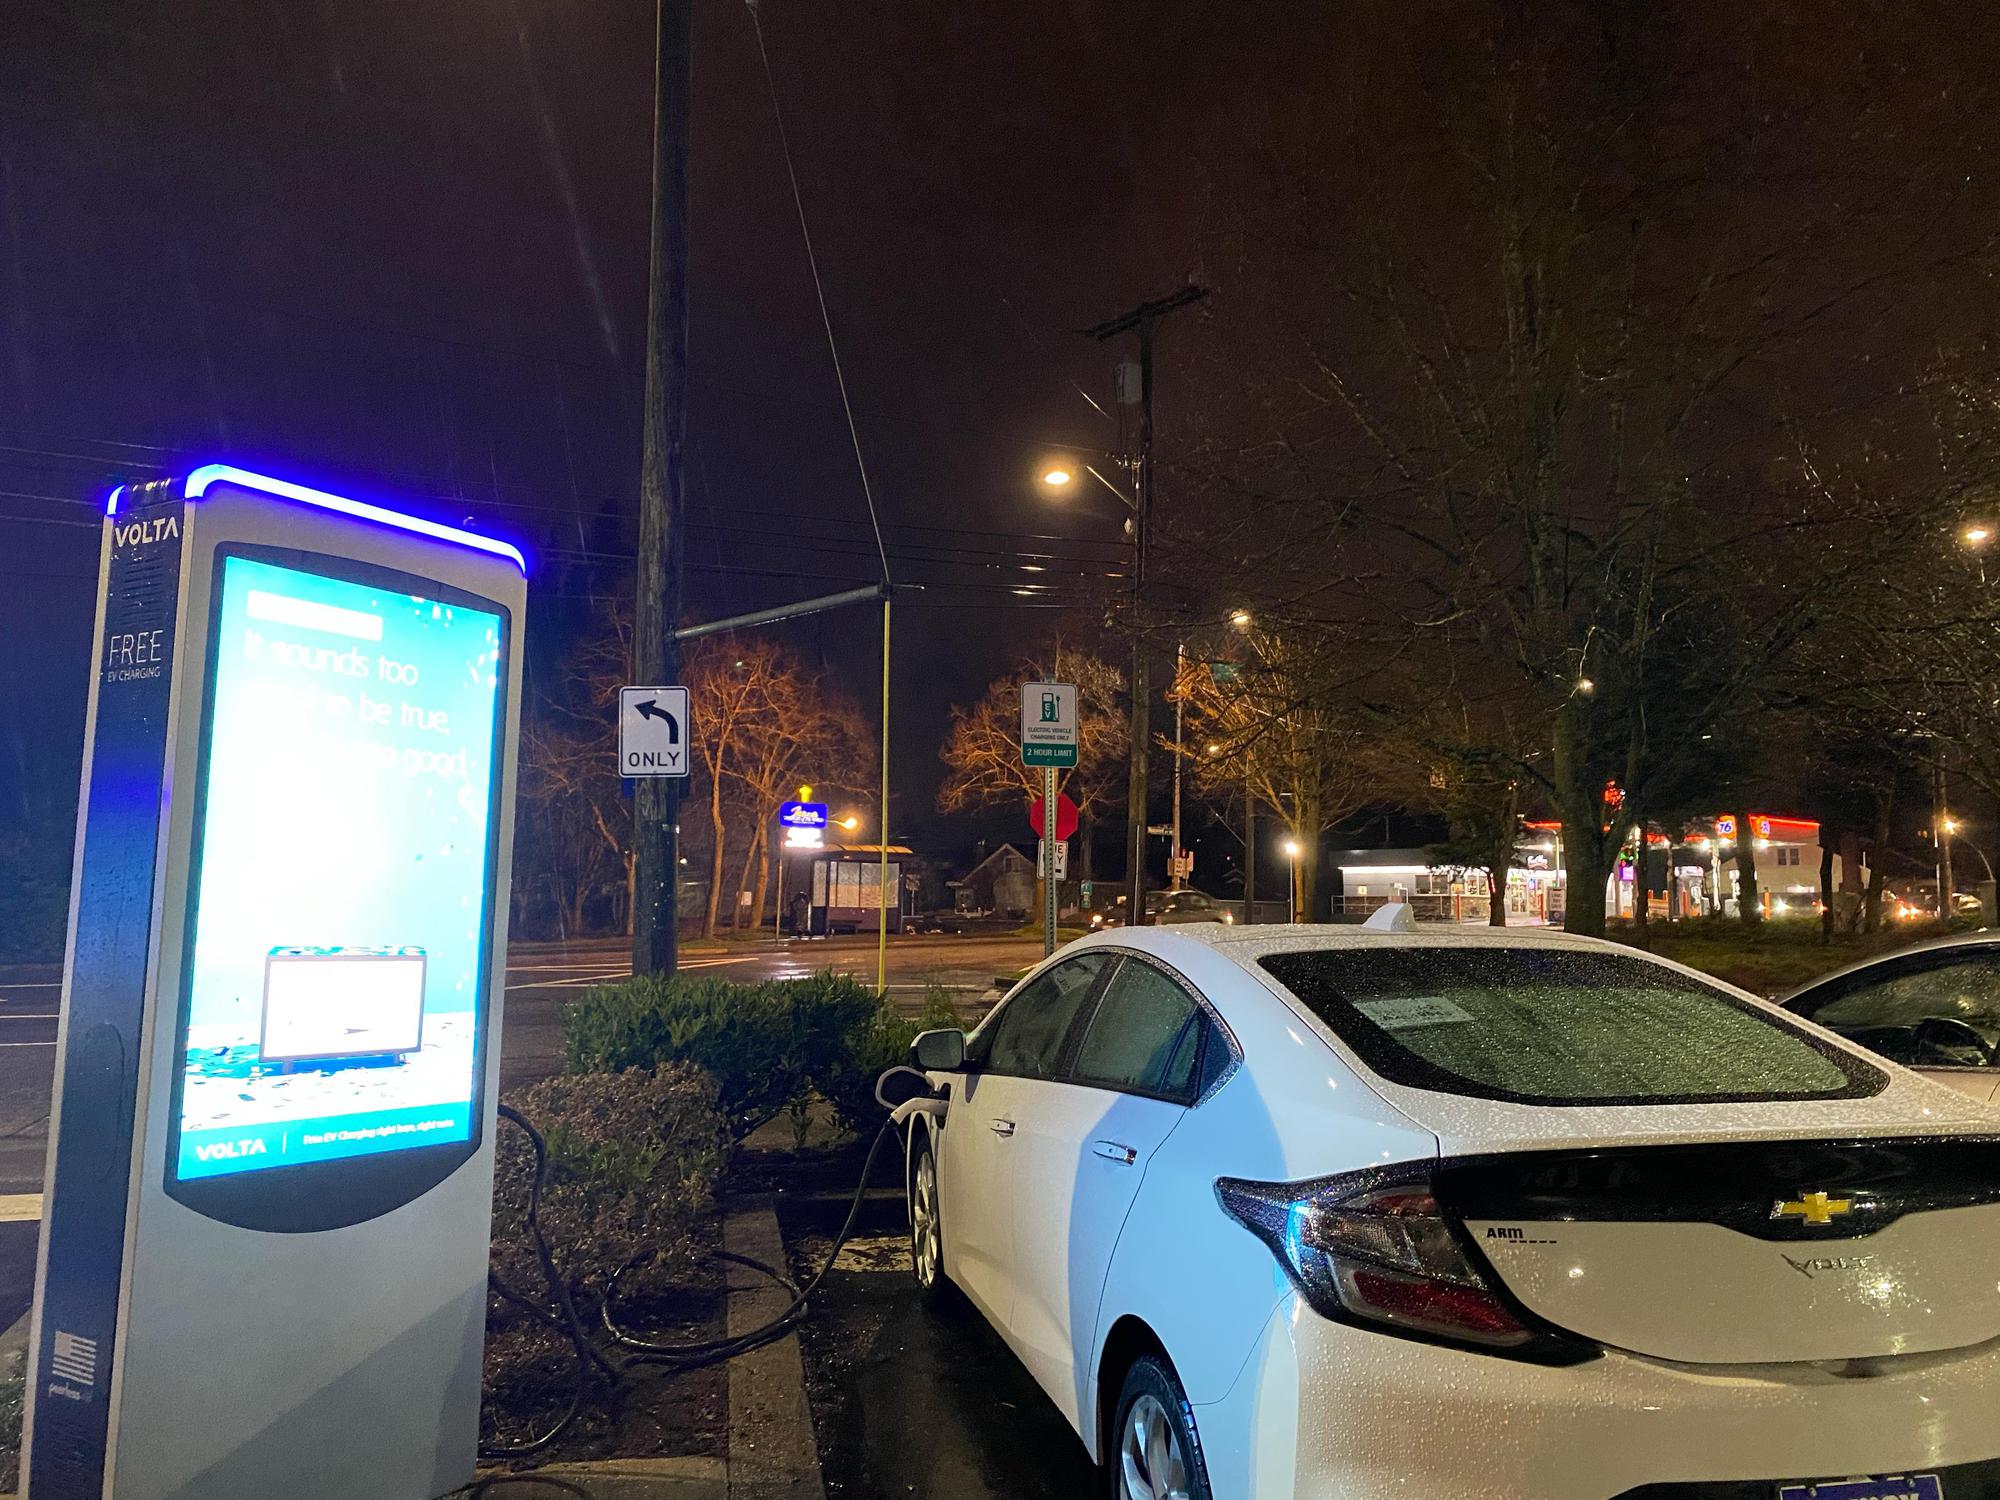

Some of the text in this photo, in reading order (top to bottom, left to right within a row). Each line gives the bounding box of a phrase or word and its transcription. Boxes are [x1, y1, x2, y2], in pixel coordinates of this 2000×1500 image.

[115, 516, 178, 547] VOLTA
[109, 630, 163, 666] FREE
[108, 666, 161, 682] EV CHARGING
[378, 655, 419, 686] too
[360, 691, 391, 725] be
[628, 752, 680, 767] ONLY
[1054, 749, 1072, 757] LIMIT
[1719, 821, 1732, 833] 76
[196, 1138, 267, 1160] VOLTA
